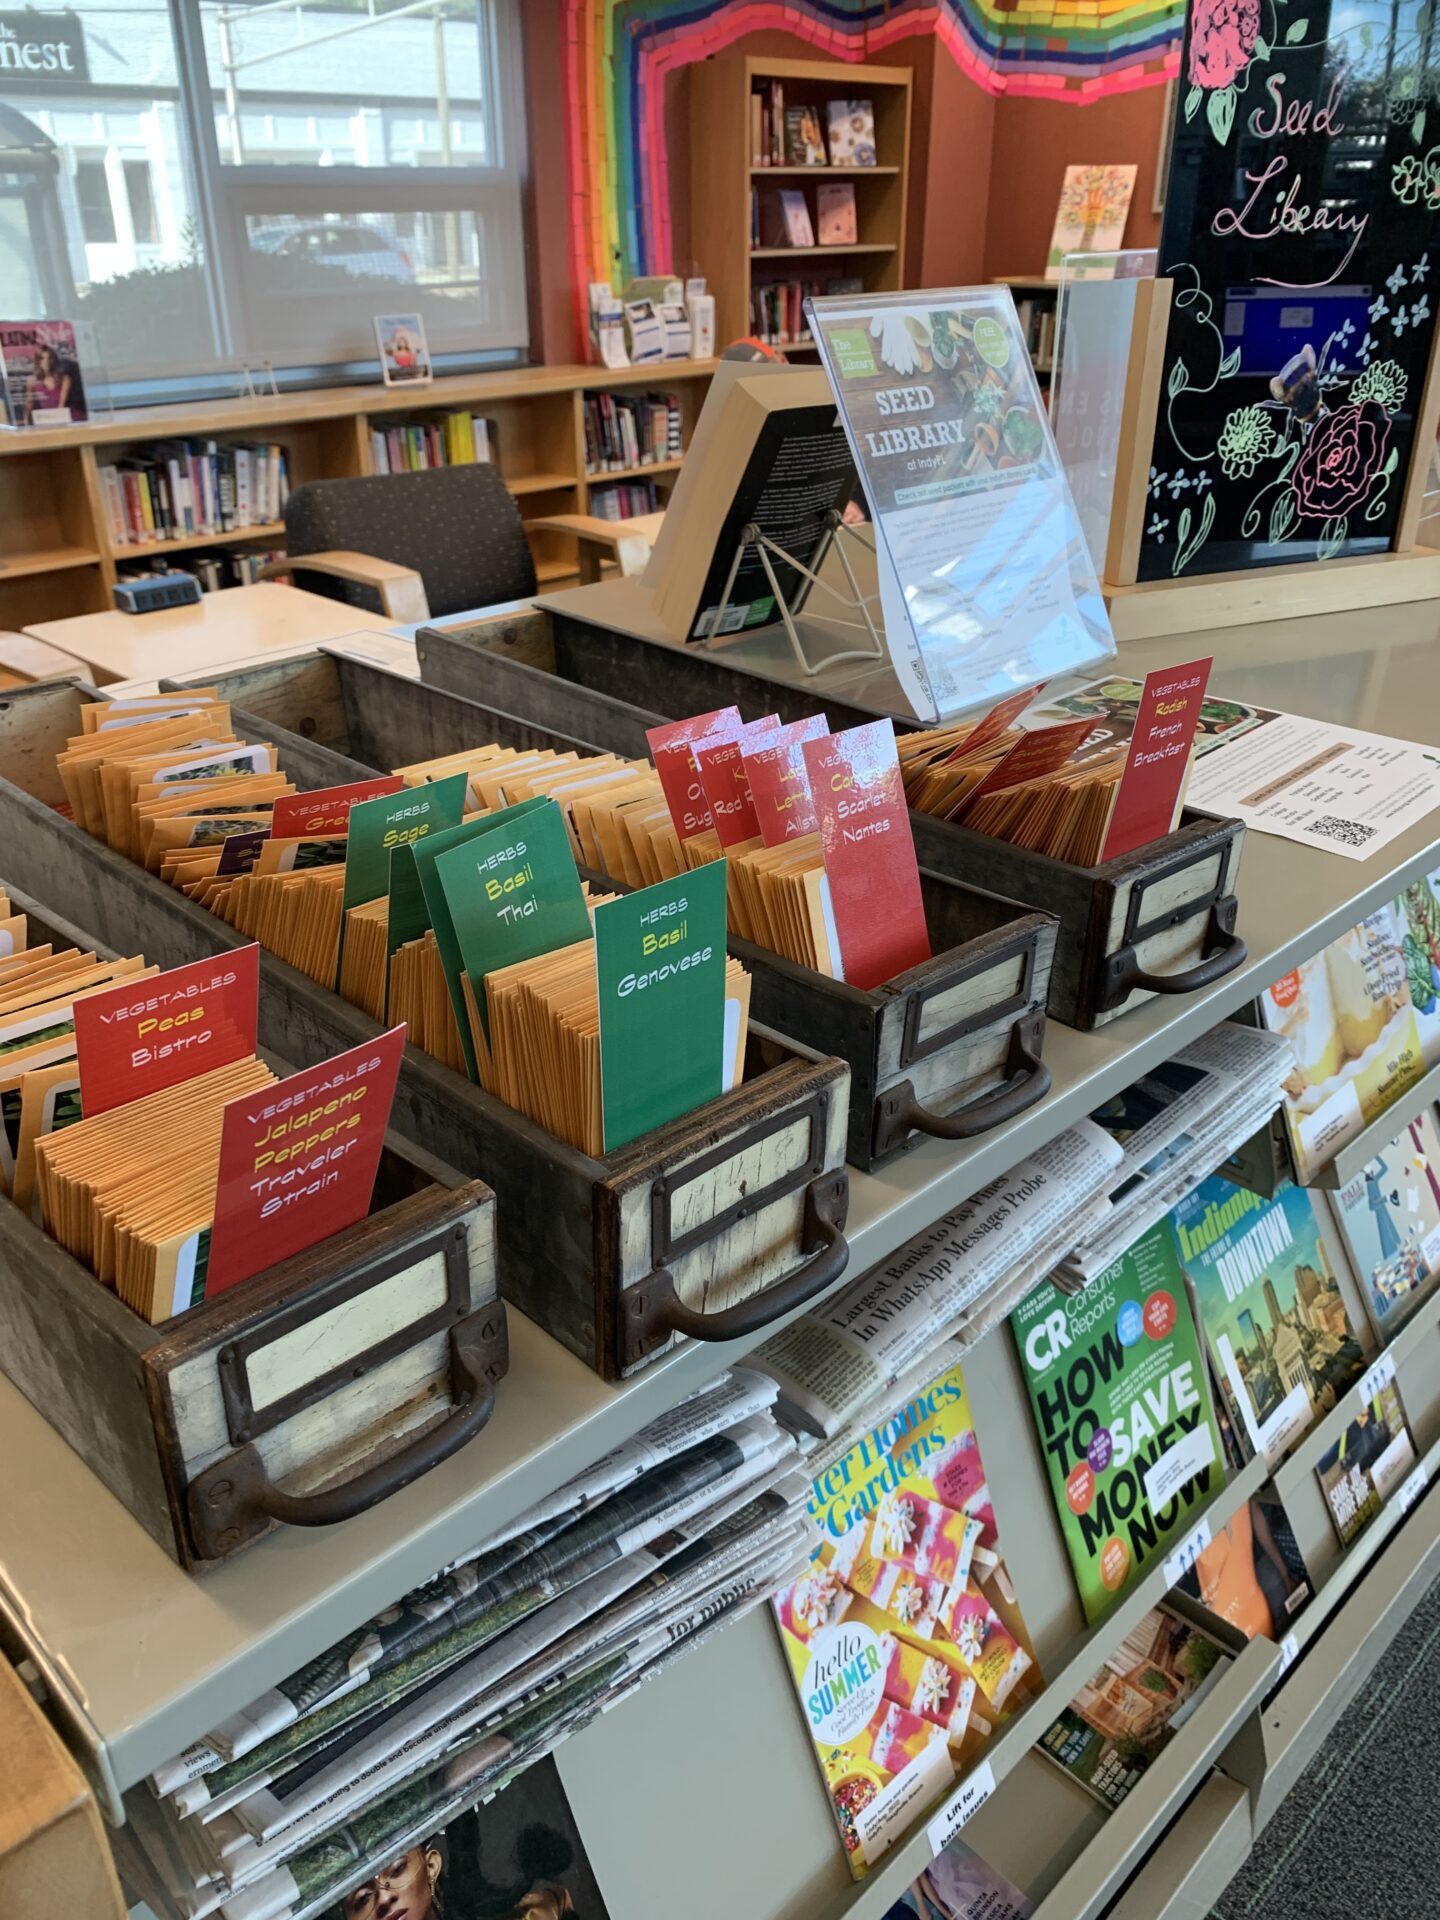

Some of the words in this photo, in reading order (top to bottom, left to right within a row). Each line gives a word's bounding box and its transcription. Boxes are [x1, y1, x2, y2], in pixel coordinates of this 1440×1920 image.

[1248, 65, 1349, 139] Seed
[1211, 155, 1369, 288] Library
[840, 357, 875, 371] Library
[875, 385, 935, 416] SEED
[865, 419, 966, 458] LIBRARY
[907, 459, 919, 471] at
[919, 455, 947, 470] IndyPL
[1151, 676, 1200, 698] VEGETABLES
[1155, 696, 1188, 717] Radish
[1148, 720, 1183, 741] French
[1133, 742, 1185, 768] Breakfast
[386, 801, 431, 825] HERBS
[714, 795, 742, 817] Red
[837, 791, 886, 819] Scarlet
[383, 823, 430, 849] Sage
[843, 819, 890, 845] Nantes
[477, 841, 527, 875] HERBS
[485, 862, 534, 901] Basil
[496, 895, 539, 927] Thai
[640, 897, 689, 927] HERBS
[642, 919, 688, 956] Basil
[617, 946, 712, 998] Genovese
[99, 971, 237, 1025] VEGETABLES
[137, 1005, 205, 1039] Peas
[131, 1029, 212, 1068] Bistro
[247, 1056, 382, 1124] VEGETABLES
[254, 1085, 368, 1147] Jalapeno
[254, 1113, 361, 1174] Peppers
[250, 1139, 357, 1197] Traveler
[260, 1171, 338, 1219] Strain
[831, 1280, 892, 1329] Largest
[885, 1242, 935, 1281] Banks
[929, 1227, 950, 1246] to
[943, 1205, 976, 1229] Pay
[966, 1174, 1010, 1207] Fines
[851, 1322, 879, 1344] In
[870, 1256, 951, 1324] WhatsApp
[944, 1203, 1012, 1260] Messages
[1001, 1172, 1047, 1208] Probe
[1215, 1202, 1293, 1303] DOWNTOWN
[1065, 1258, 1124, 1318] Consumer
[1019, 1311, 1035, 1324] LOVE
[1035, 1292, 1056, 1312] DRIVING
[1070, 1290, 1116, 1341] Reports
[1025, 1309, 1073, 1371] CR
[1037, 1329, 1124, 1439] HOW
[859, 1376, 961, 1469] Homes
[1047, 1408, 1099, 1481] TO
[1109, 1360, 1200, 1468] SAVE
[826, 1424, 946, 1537] Gardens
[1077, 1402, 1202, 1558] MONEY
[1127, 1463, 1211, 1564] NOW
[667, 1615, 695, 1641] for
[699, 1578, 756, 1622] public
[815, 1635, 861, 1689] hello
[809, 1644, 881, 1725] SUMMER
[184, 1750, 211, 1768] views
[310, 1800, 327, 1813] was
[328, 1784, 350, 1803] going
[351, 1777, 360, 1787] to
[361, 1759, 387, 1781] double
[388, 1750, 403, 1763] and
[403, 1731, 433, 1753] become
[433, 1701, 481, 1735] unaffordable.
[1087, 1748, 1121, 1786] RIGHT-SIZED
[1095, 1759, 1124, 1791] TRACTORS
[1104, 1782, 1119, 1798] FOR
[1112, 1767, 1129, 1786] YOUR
[940, 1823, 962, 1848] back
[962, 1790, 989, 1823] issues
[946, 1800, 962, 1822] Lift
[963, 1787, 975, 1803] for
[967, 1892, 987, 1915] QUINTA
[973, 1890, 999, 1920] BRUNSON
